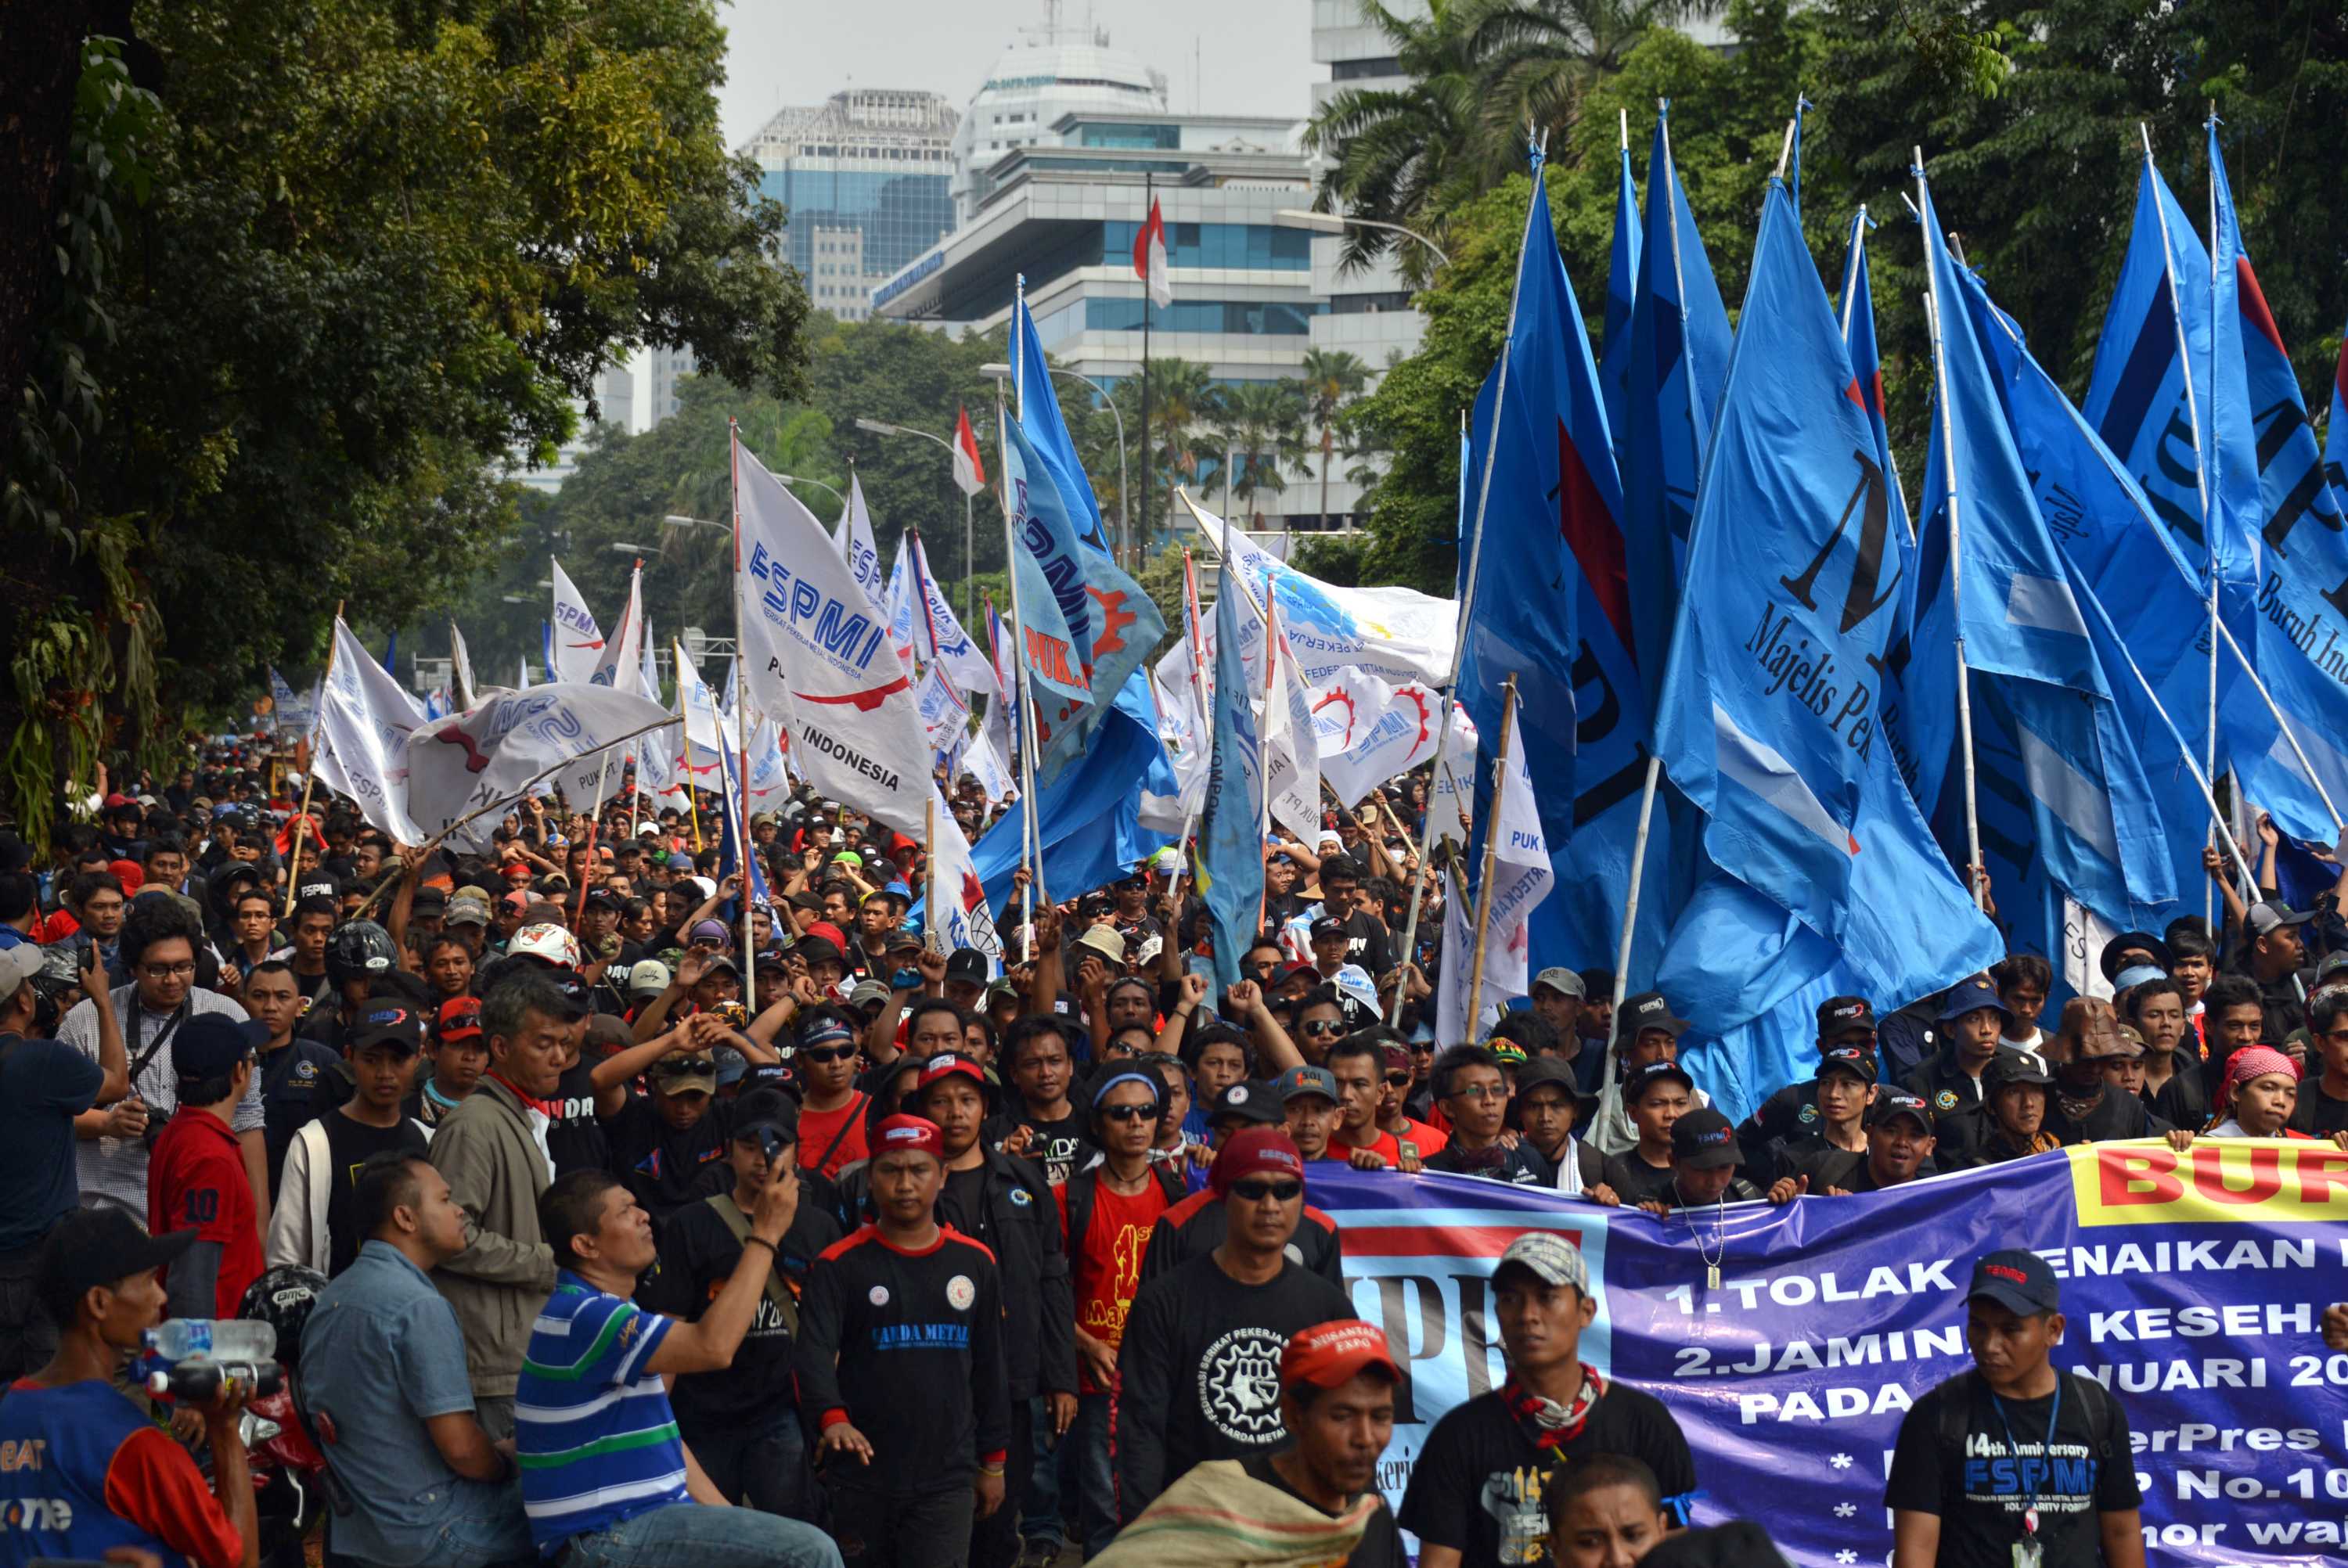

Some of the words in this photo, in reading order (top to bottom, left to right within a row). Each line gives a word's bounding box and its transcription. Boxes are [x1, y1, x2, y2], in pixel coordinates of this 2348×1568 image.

[749, 540, 884, 671] FSPMI
[2259, 570, 2320, 657] Buruh
[1745, 601, 1838, 717] Majelis
[803, 725, 899, 792] INDONESIA
[1511, 830, 1539, 852] PUK
[301, 883, 333, 898] FSPMI
[184, 1189, 219, 1222] 10
[277, 1289, 306, 1302] BMC
[1200, 1333, 1233, 1372] SERIKAT
[1233, 1328, 1284, 1343] PEKERJA
[1740, 1383, 1913, 1424] PADA
[1219, 1422, 1256, 1444] GARDA
[1965, 1432, 2006, 1458] 14th
